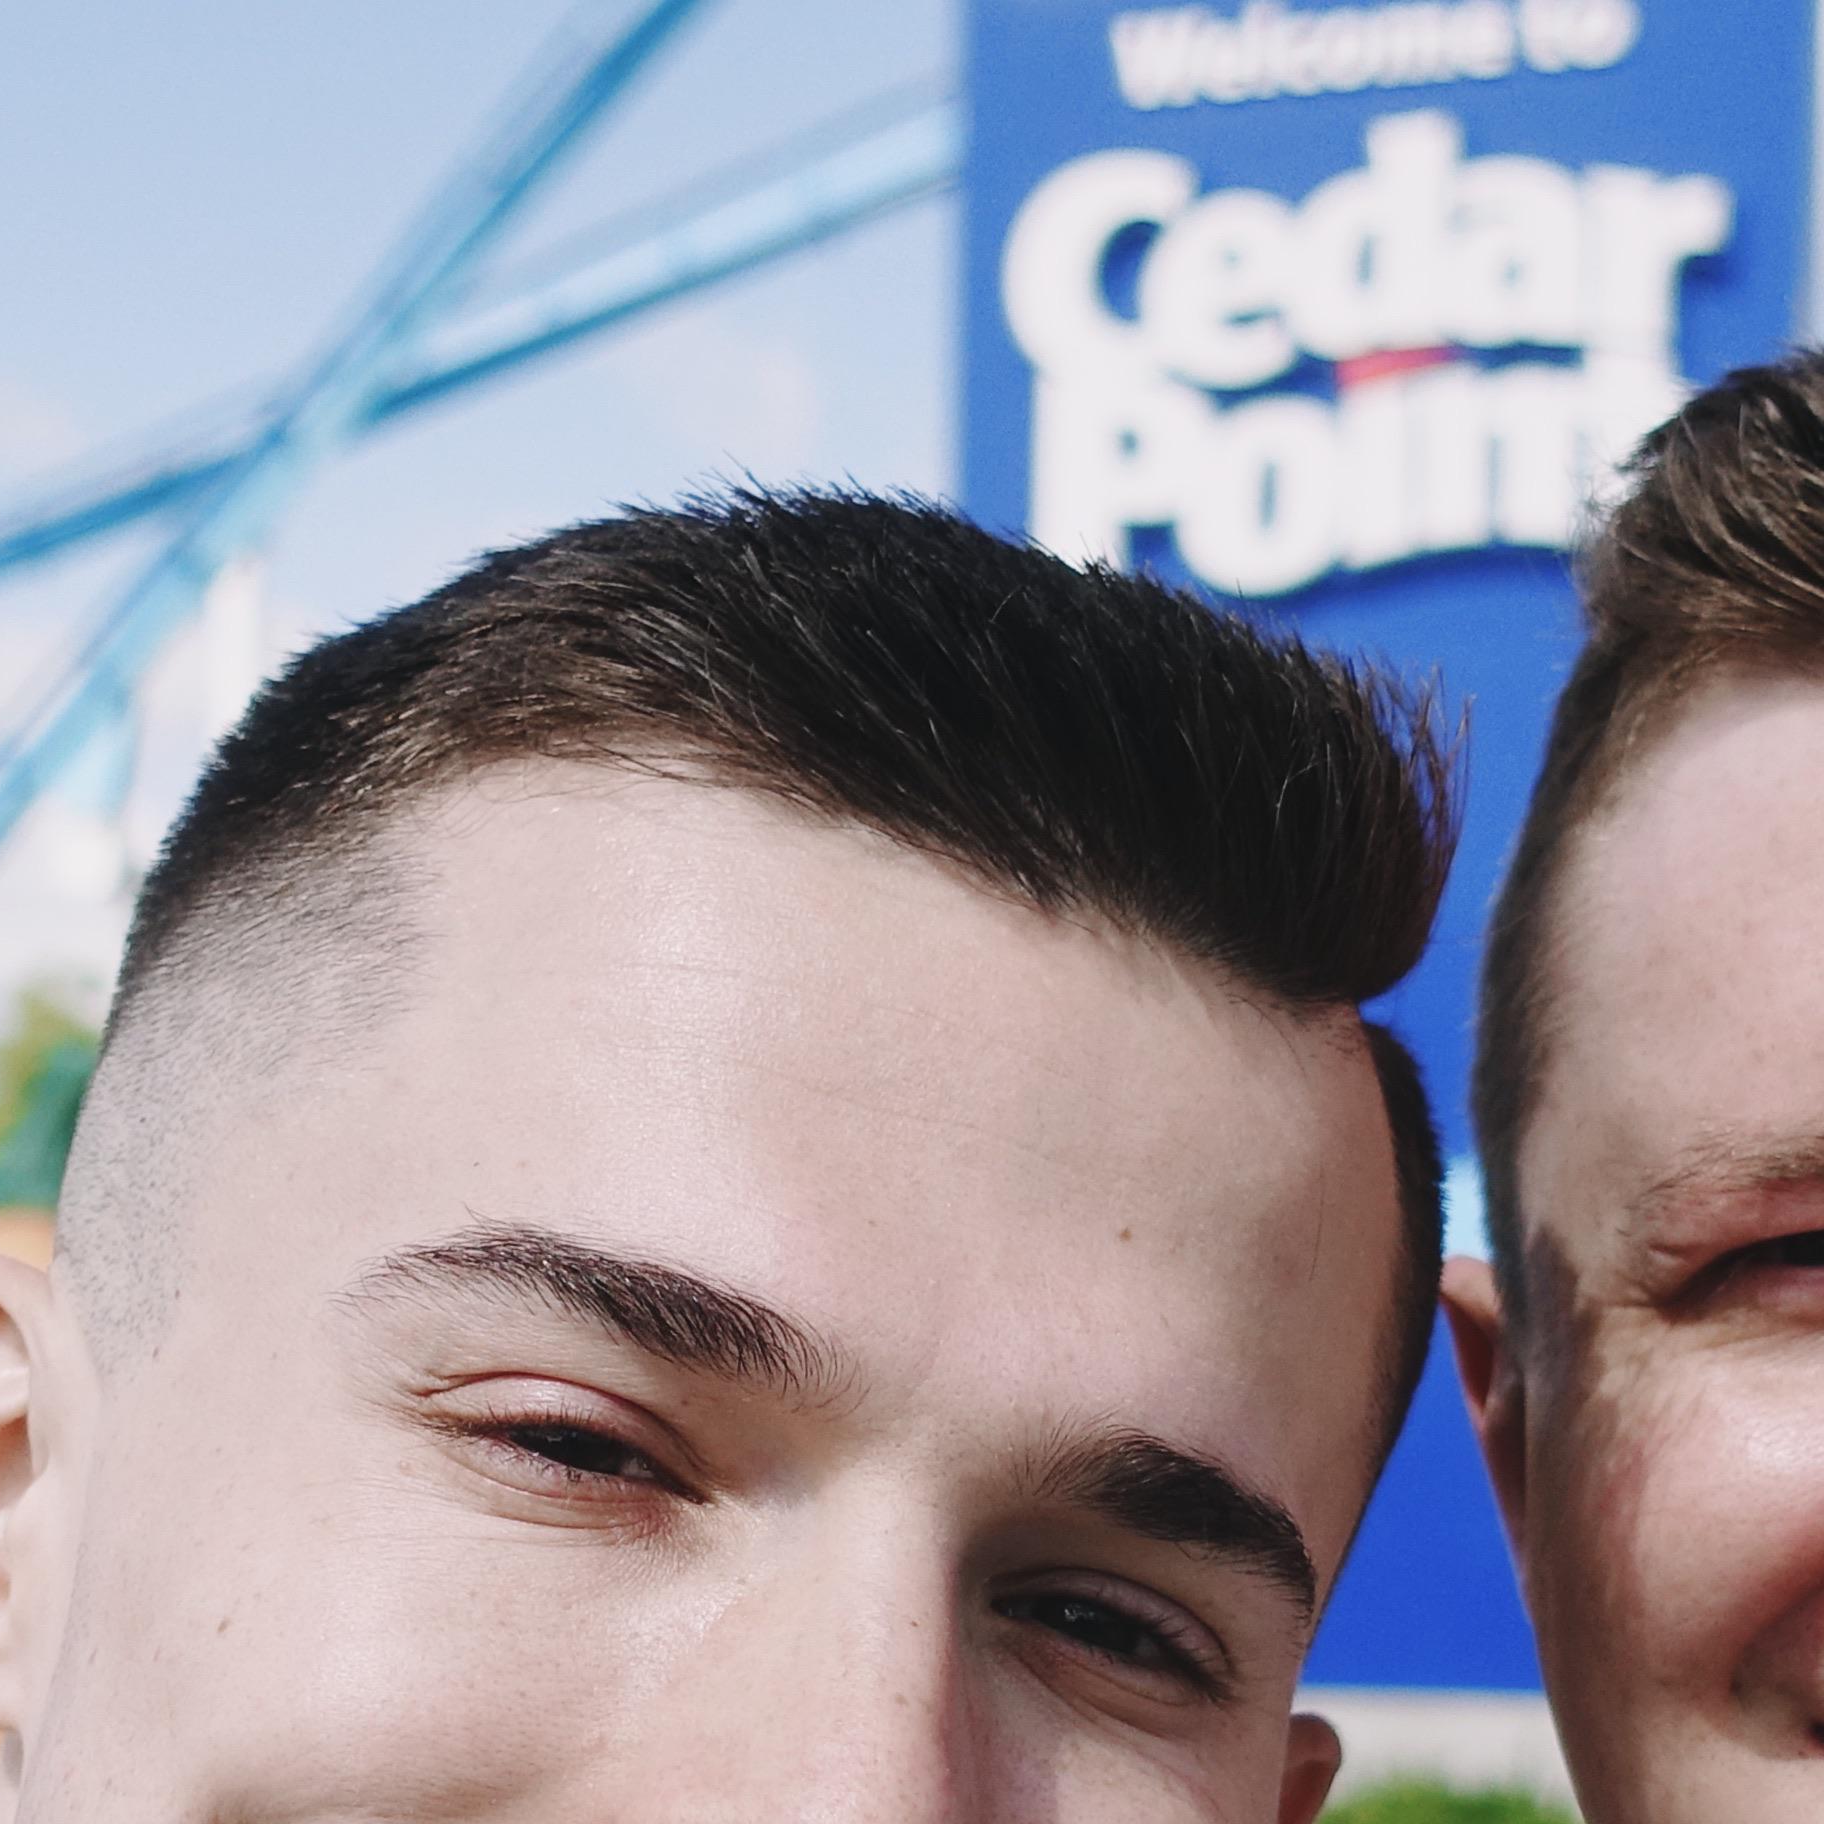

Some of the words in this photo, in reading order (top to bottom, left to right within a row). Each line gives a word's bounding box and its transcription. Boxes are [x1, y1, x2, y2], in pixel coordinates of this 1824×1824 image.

[1109, 0, 1514, 109] Welcome
[1520, 0, 1637, 72] to
[1002, 109, 1736, 390] Cedar
